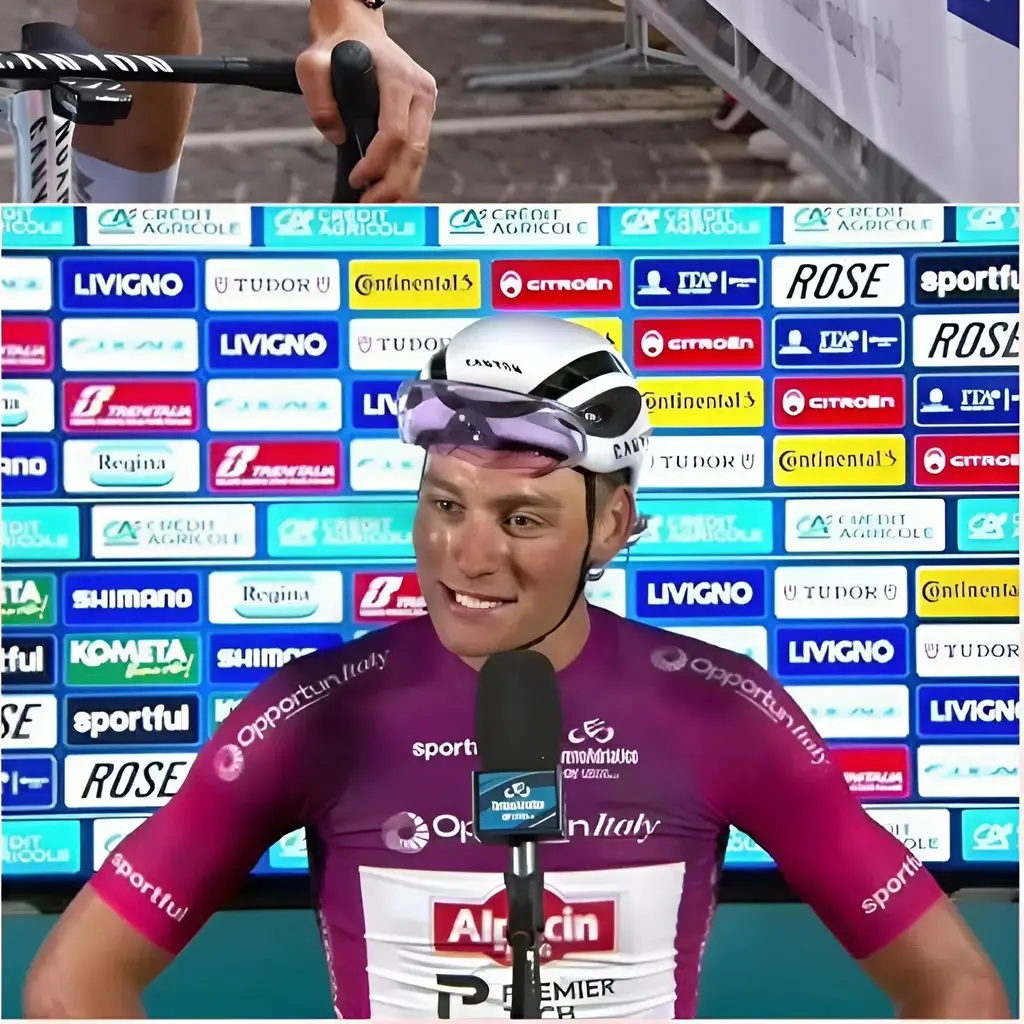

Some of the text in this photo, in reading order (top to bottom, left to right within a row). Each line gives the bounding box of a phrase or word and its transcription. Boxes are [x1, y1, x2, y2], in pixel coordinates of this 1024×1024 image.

[30, 115, 48, 203] CANY
[74, 272, 184, 296] LIVIGNO
[234, 278, 310, 292] TUDOR
[787, 263, 890, 299] ROSE
[220, 332, 327, 357] LIVIGNO
[660, 455, 735, 469] TUDOR
[72, 588, 193, 609] SHIMANO
[647, 581, 753, 605] LIVIGNO
[804, 586, 878, 601] TUDOR
[70, 638, 187, 666] KOMETA
[789, 639, 894, 664] LIVIGNO
[73, 703, 189, 739] sportful
[82, 761, 187, 799] ROSE
[111, 852, 189, 922] sportful
